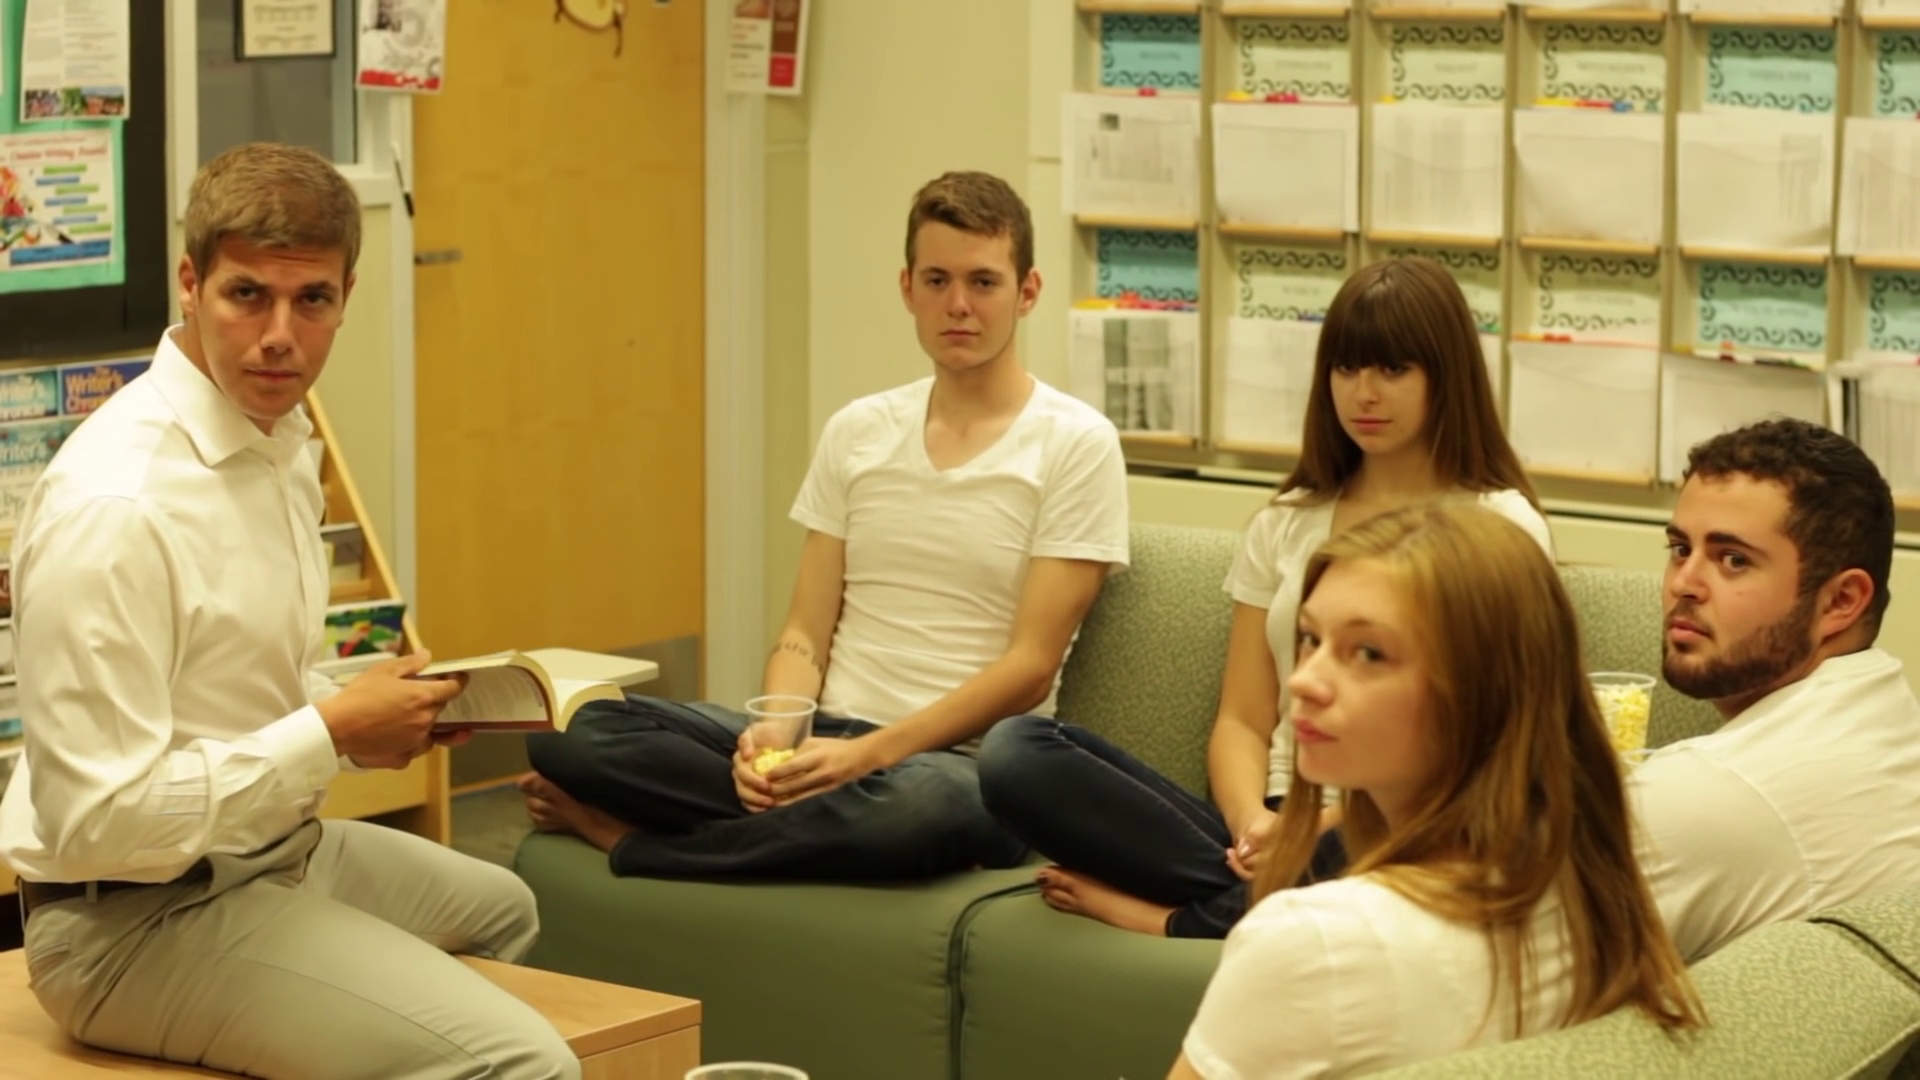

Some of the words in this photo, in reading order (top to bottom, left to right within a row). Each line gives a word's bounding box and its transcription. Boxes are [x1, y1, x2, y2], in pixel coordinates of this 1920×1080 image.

[0, 377, 46, 401] riter's
[65, 369, 125, 399] Writer's
[0, 442, 48, 466] riter's
